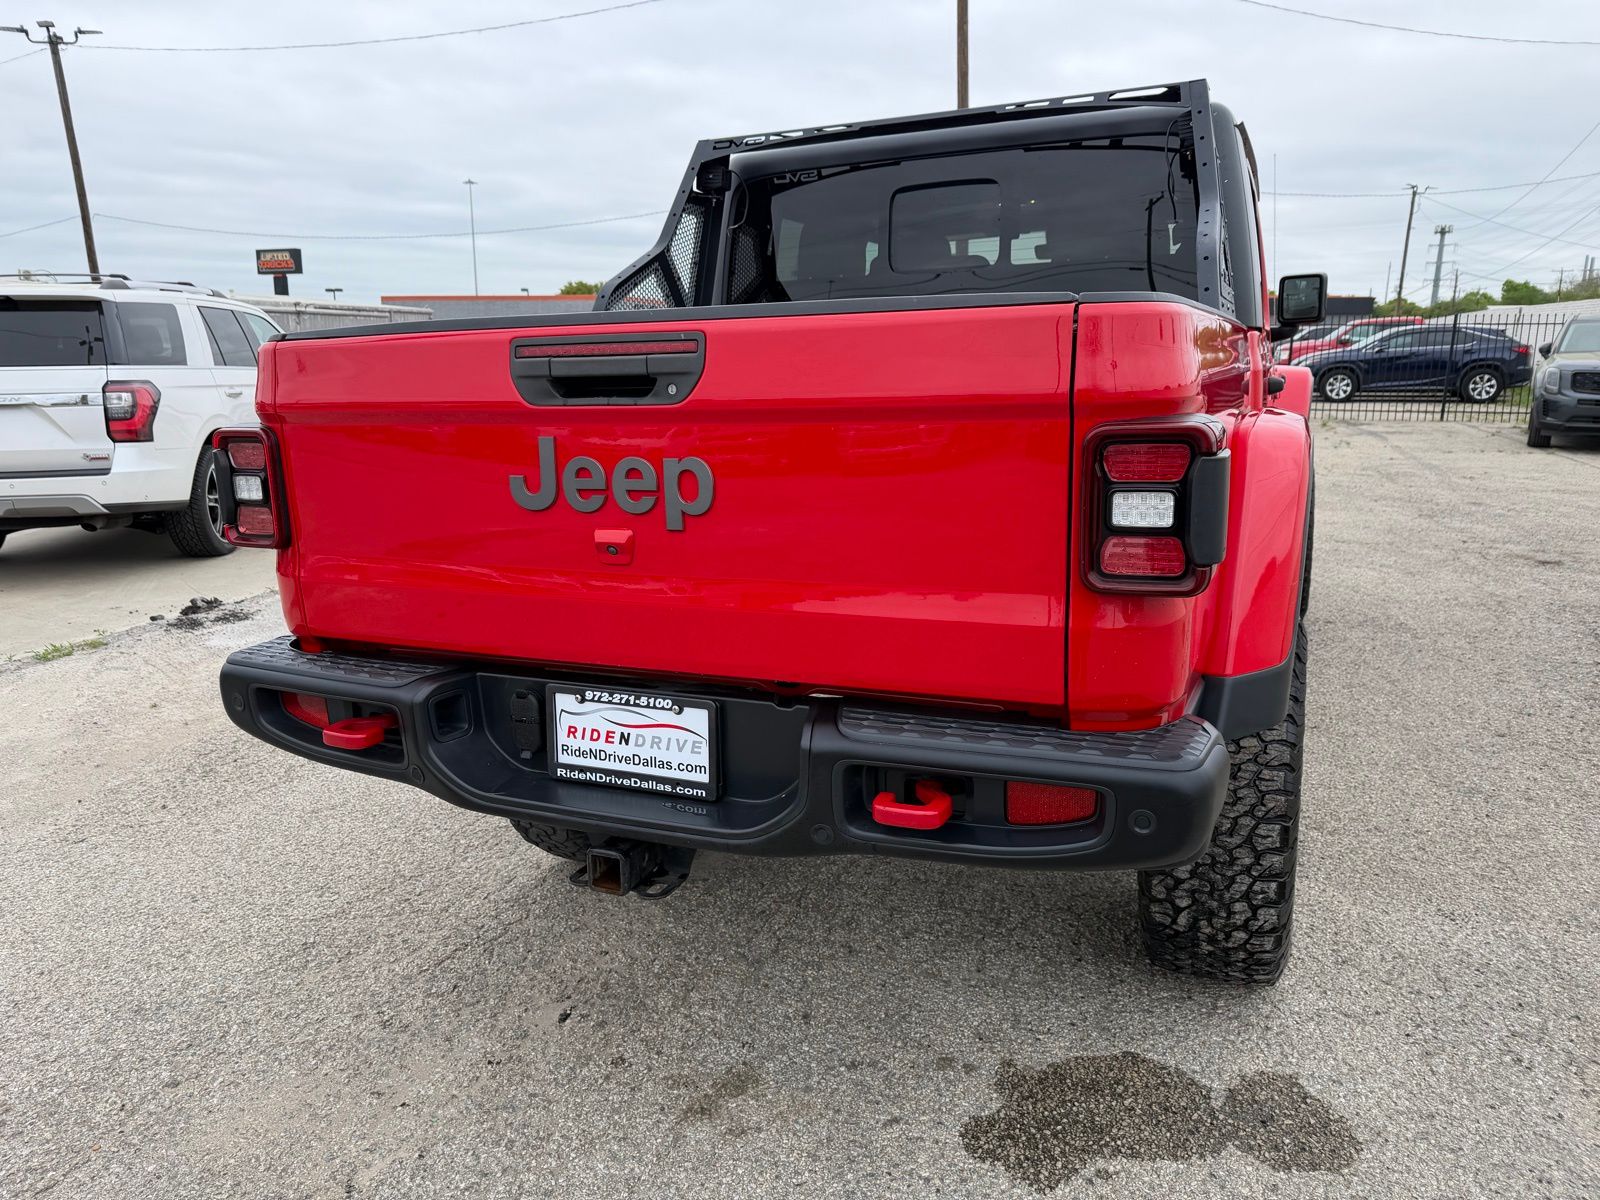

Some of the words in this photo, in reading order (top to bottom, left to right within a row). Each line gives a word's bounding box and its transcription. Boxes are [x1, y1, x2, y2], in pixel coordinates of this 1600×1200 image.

[509, 436, 715, 531] Jeep
[585, 691, 673, 709] 972-271-5100
[561, 744, 707, 775] RideNDriveDallas.com
[556, 768, 706, 797] RideNDriveDallas.com
